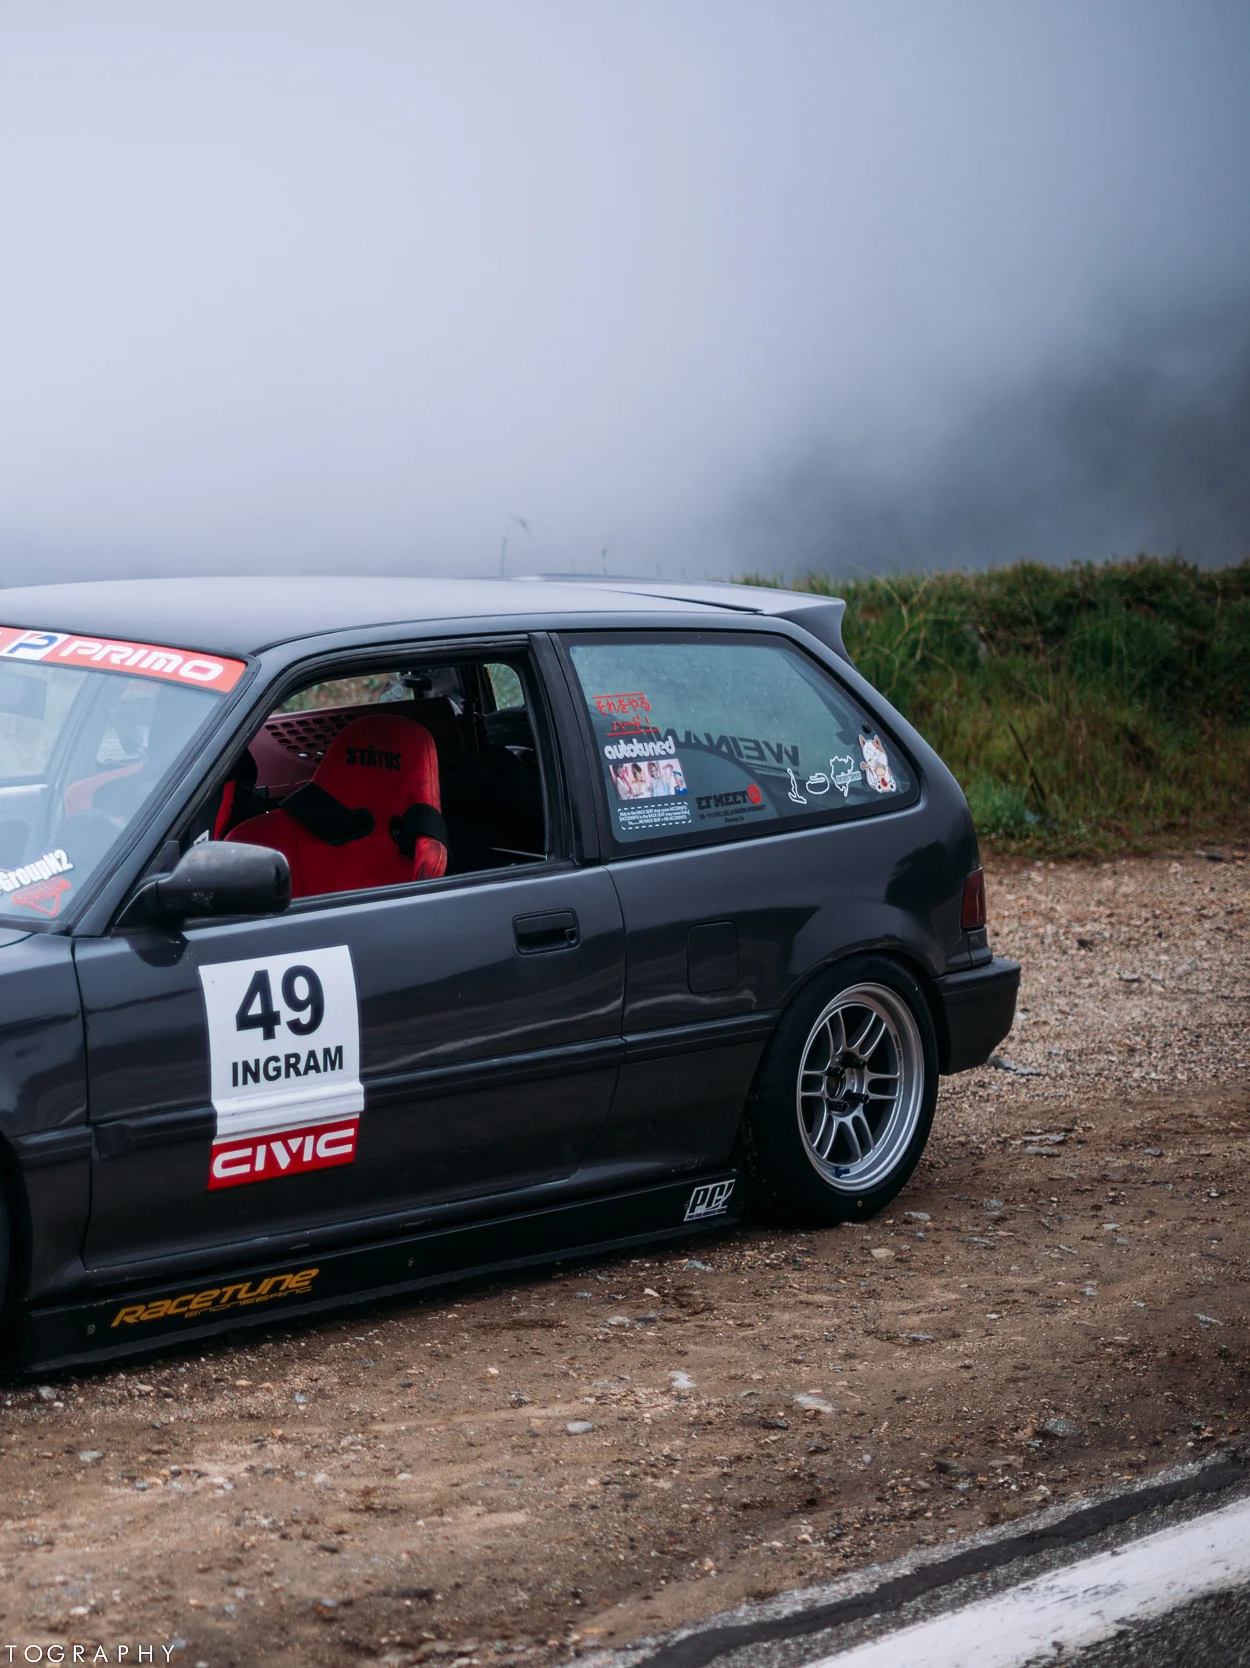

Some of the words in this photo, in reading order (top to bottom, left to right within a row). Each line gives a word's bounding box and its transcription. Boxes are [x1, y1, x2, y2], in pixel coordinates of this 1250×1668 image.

[59, 641, 223, 681] PRIMO
[604, 735, 675, 760] autotuned
[235, 964, 325, 1042] 49
[232, 1045, 344, 1088] INGRAM
[212, 1127, 355, 1179] CIVIC
